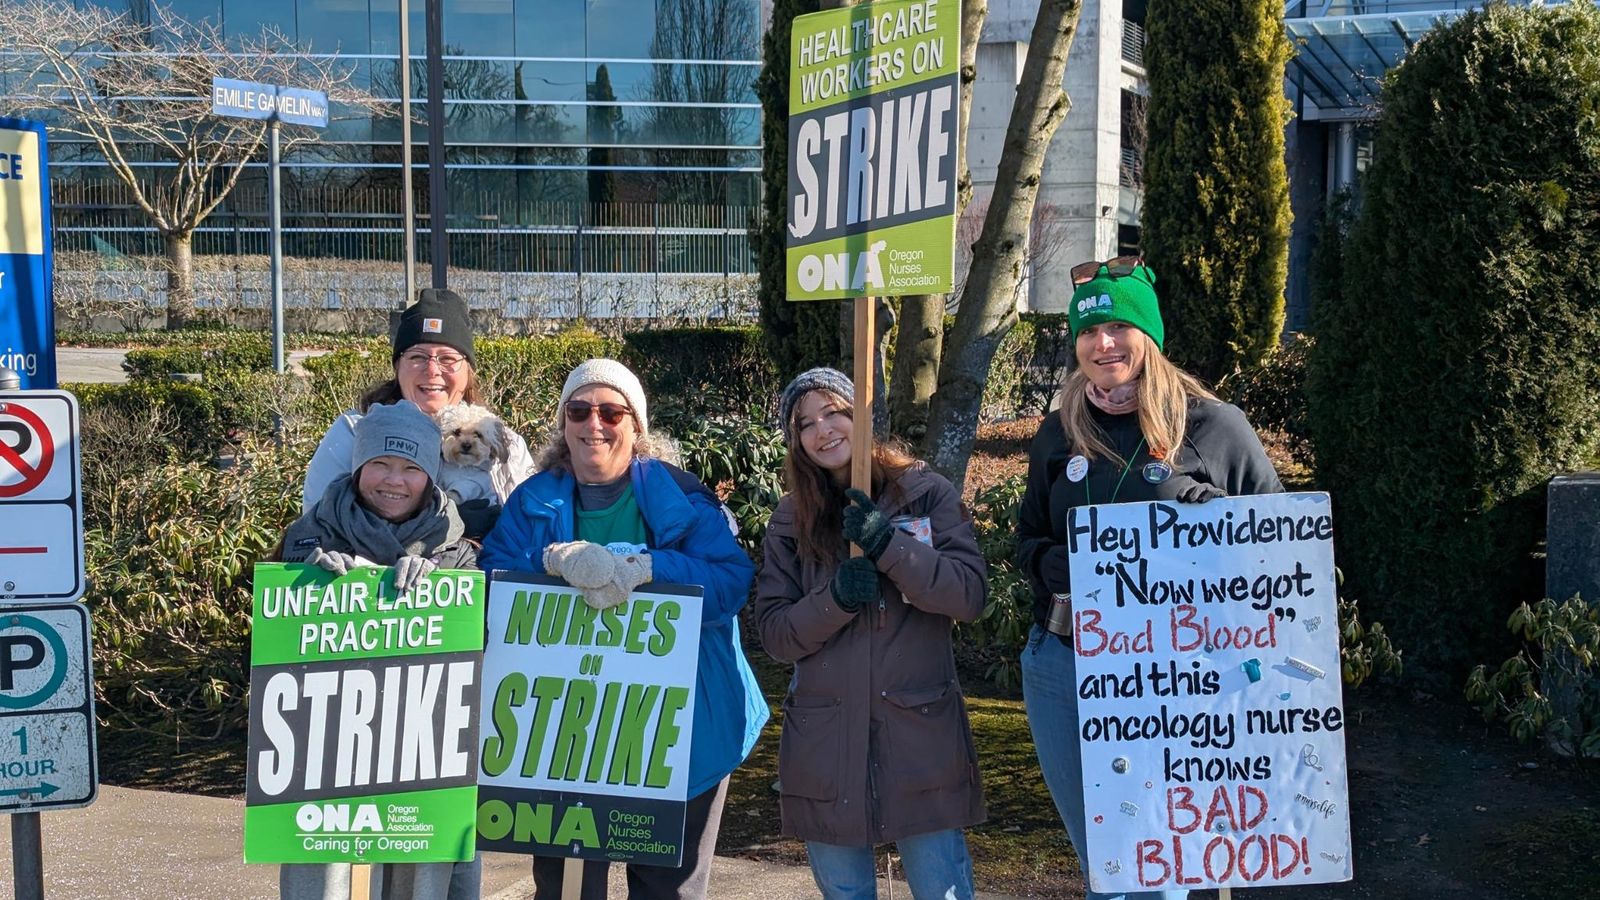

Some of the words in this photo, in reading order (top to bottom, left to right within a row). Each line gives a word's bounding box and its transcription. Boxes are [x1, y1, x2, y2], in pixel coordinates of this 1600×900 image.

[798, 0, 938, 68] HEALTHCARE
[800, 48, 905, 104] WORKERS
[912, 37, 944, 75] ON
[216, 88, 255, 109] EMILIE
[258, 93, 310, 116] GAMELIN
[311, 107, 325, 118] WAY
[792, 85, 952, 239] STRIKE
[797, 248, 885, 293] ONA
[889, 249, 924, 263] Oregon
[889, 263, 922, 275] Nurses
[889, 274, 940, 287] Association
[1077, 294, 1112, 312] ONA
[388, 440, 415, 452] PNW
[1067, 506, 1140, 563] Hey
[1149, 502, 1333, 549] Providence
[262, 582, 368, 618] UNFAIR
[377, 576, 474, 612] LABOR
[300, 615, 443, 655] PRACTICE
[504, 590, 682, 657] NURSES
[1075, 609, 1154, 657] Bad
[0, 634, 45, 690] P
[579, 653, 603, 675] ON
[12, 726, 28, 755] 1
[257, 661, 474, 796] STRIKE
[481, 672, 689, 788] STRIKE
[1082, 704, 1235, 749] oncology
[1246, 706, 1343, 735] nurse
[1164, 747, 1272, 783] knows
[296, 803, 384, 832] ONA
[386, 823, 434, 832] Association
[387, 804, 419, 815] Oregon
[387, 814, 417, 823] Nurses
[477, 799, 601, 849] ONA
[609, 809, 655, 827] Oregon
[1167, 784, 1269, 835] BAD
[303, 837, 350, 853] Caring
[354, 837, 373, 850] for
[377, 837, 429, 853] Oregon
[606, 837, 676, 855] Association
[607, 823, 652, 840] Nurses
[1136, 833, 1312, 887] BLOOD!
